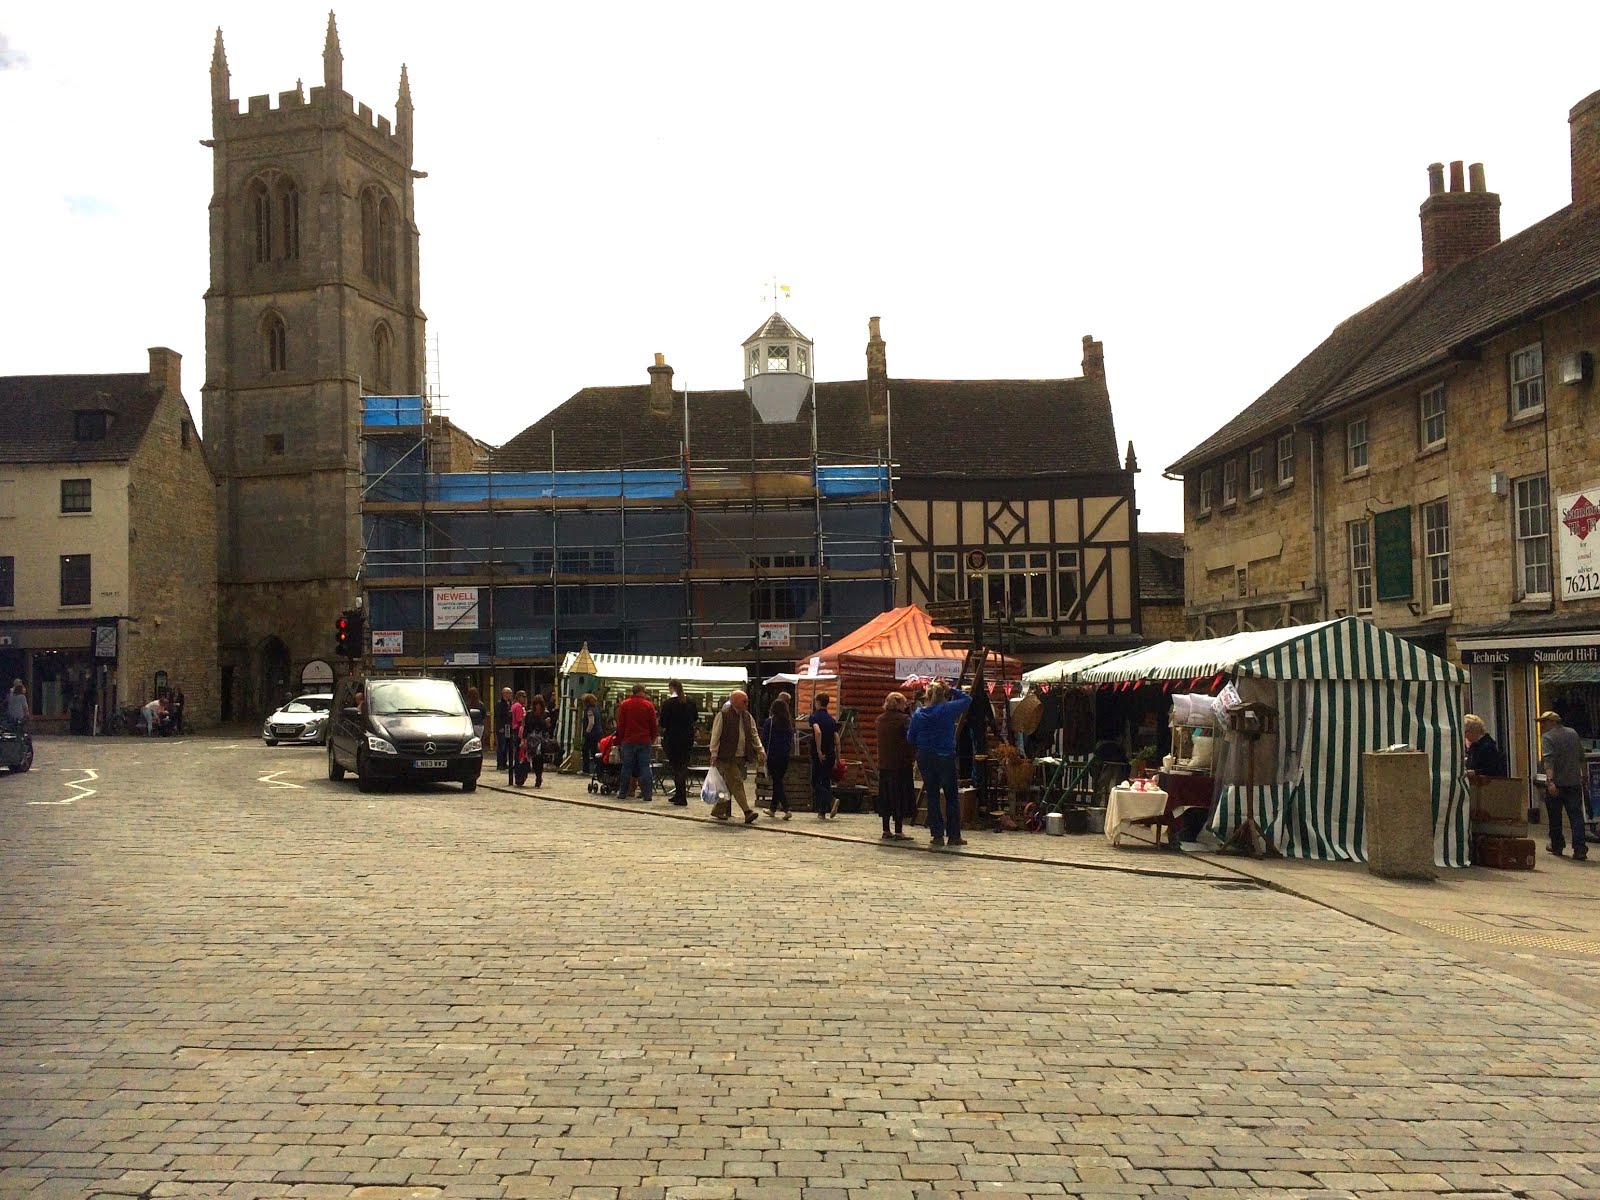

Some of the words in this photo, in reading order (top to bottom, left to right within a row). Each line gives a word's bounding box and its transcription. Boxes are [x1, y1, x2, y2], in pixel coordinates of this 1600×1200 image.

[1565, 573, 1600, 593] 76212
[436, 592, 476, 601] NEWELL
[1472, 651, 1510, 664] Technics
[1533, 649, 1574, 662] Stamford
